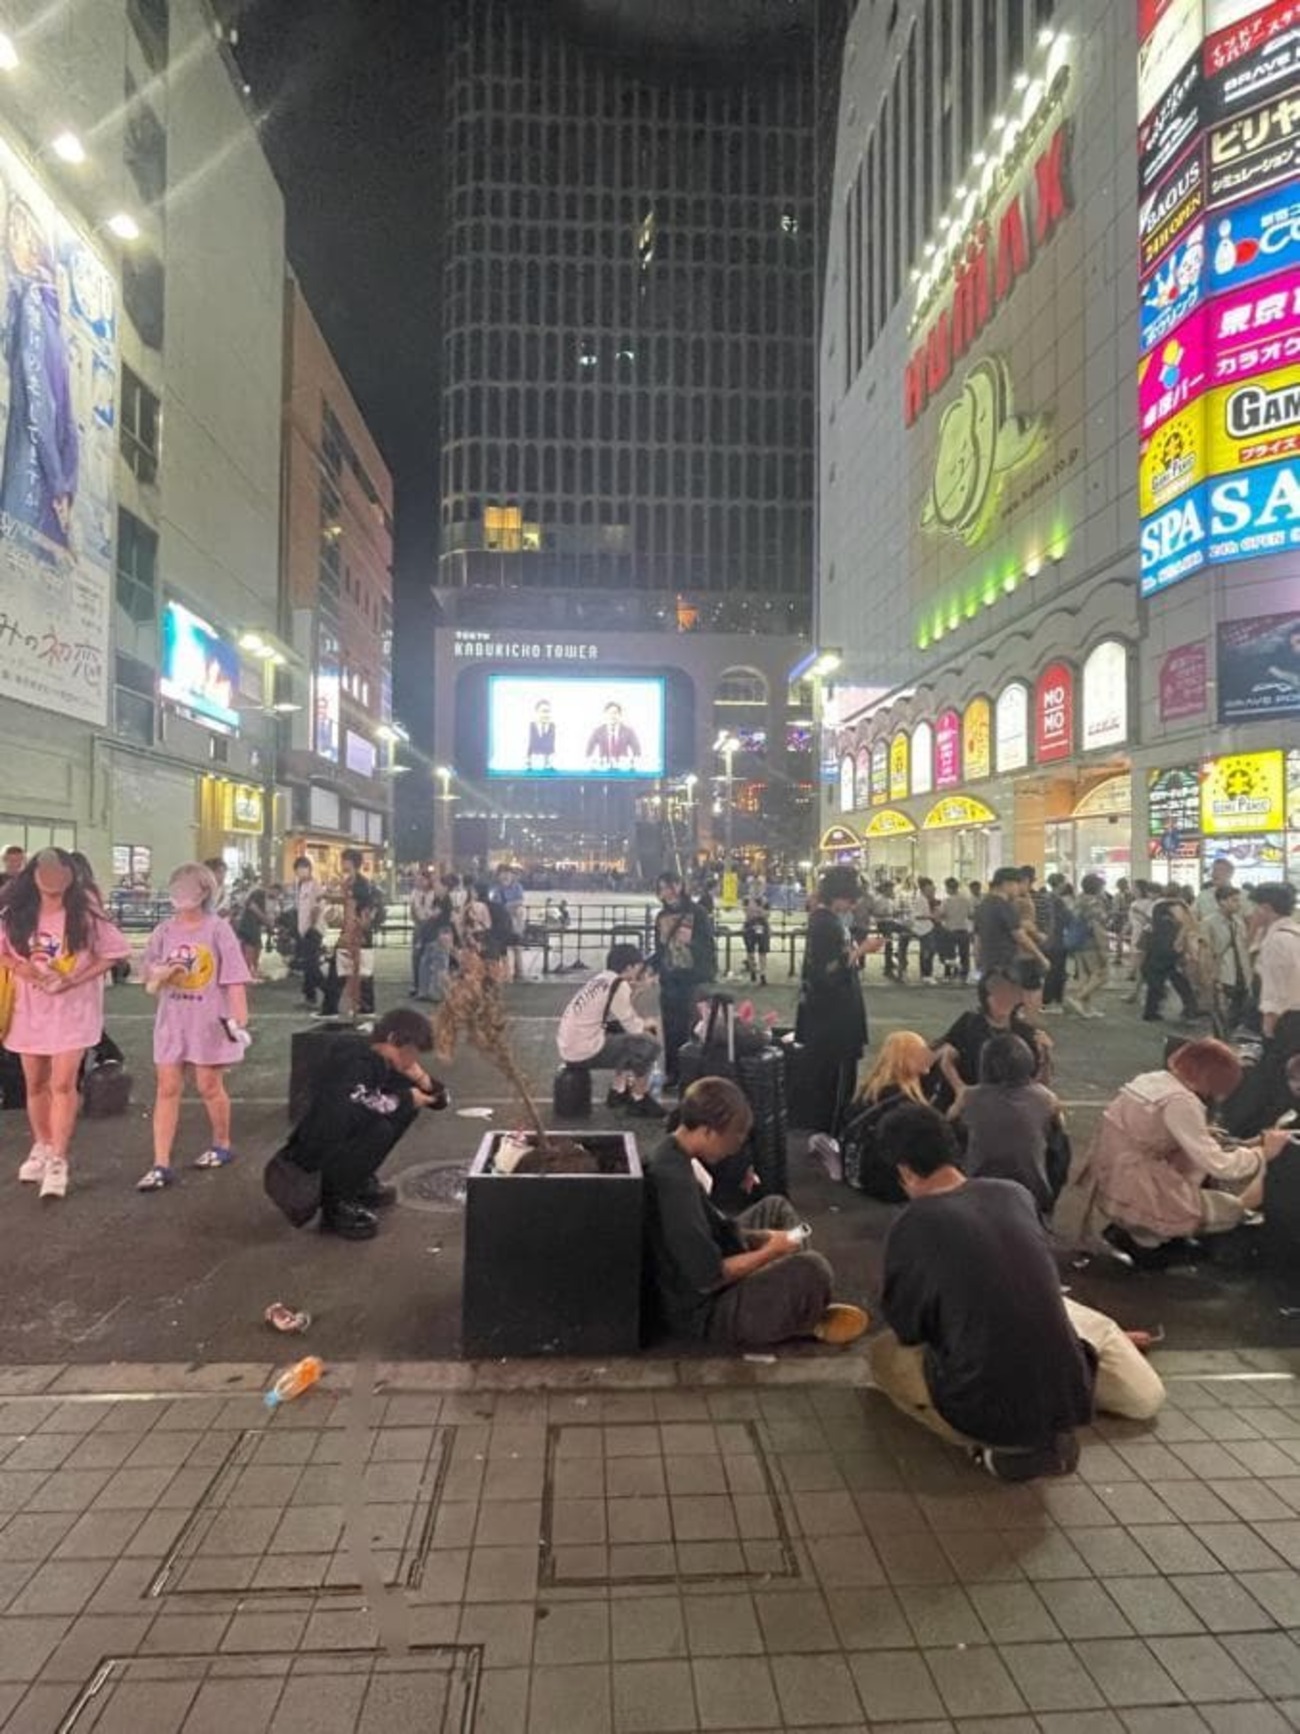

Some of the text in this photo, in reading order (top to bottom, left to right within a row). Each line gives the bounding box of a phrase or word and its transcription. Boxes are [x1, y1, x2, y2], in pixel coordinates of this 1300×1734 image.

[1217, 287, 1300, 339] 東京
[1141, 498, 1205, 570] SPA
[546, 644, 599, 660] TOWER
